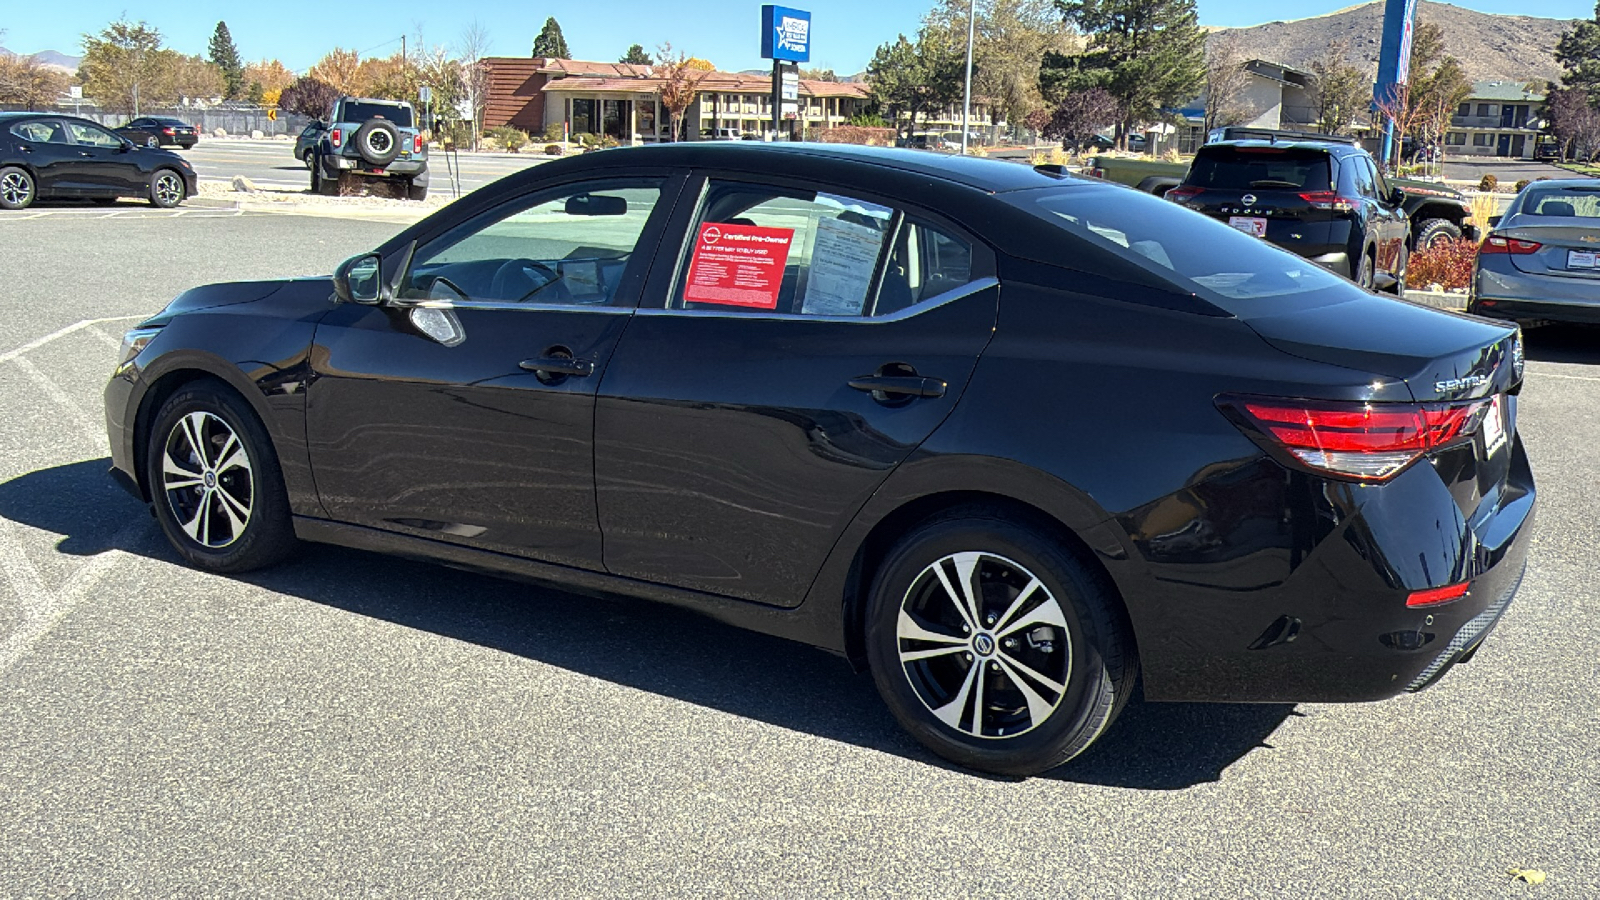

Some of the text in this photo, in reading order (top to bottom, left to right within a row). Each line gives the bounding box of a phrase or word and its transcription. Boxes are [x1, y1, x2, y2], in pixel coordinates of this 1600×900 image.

[1221, 207, 1273, 216] ROGUE
[723, 233, 789, 244] Certified Pre-Owned
[1435, 374, 1487, 393] SENTRA
